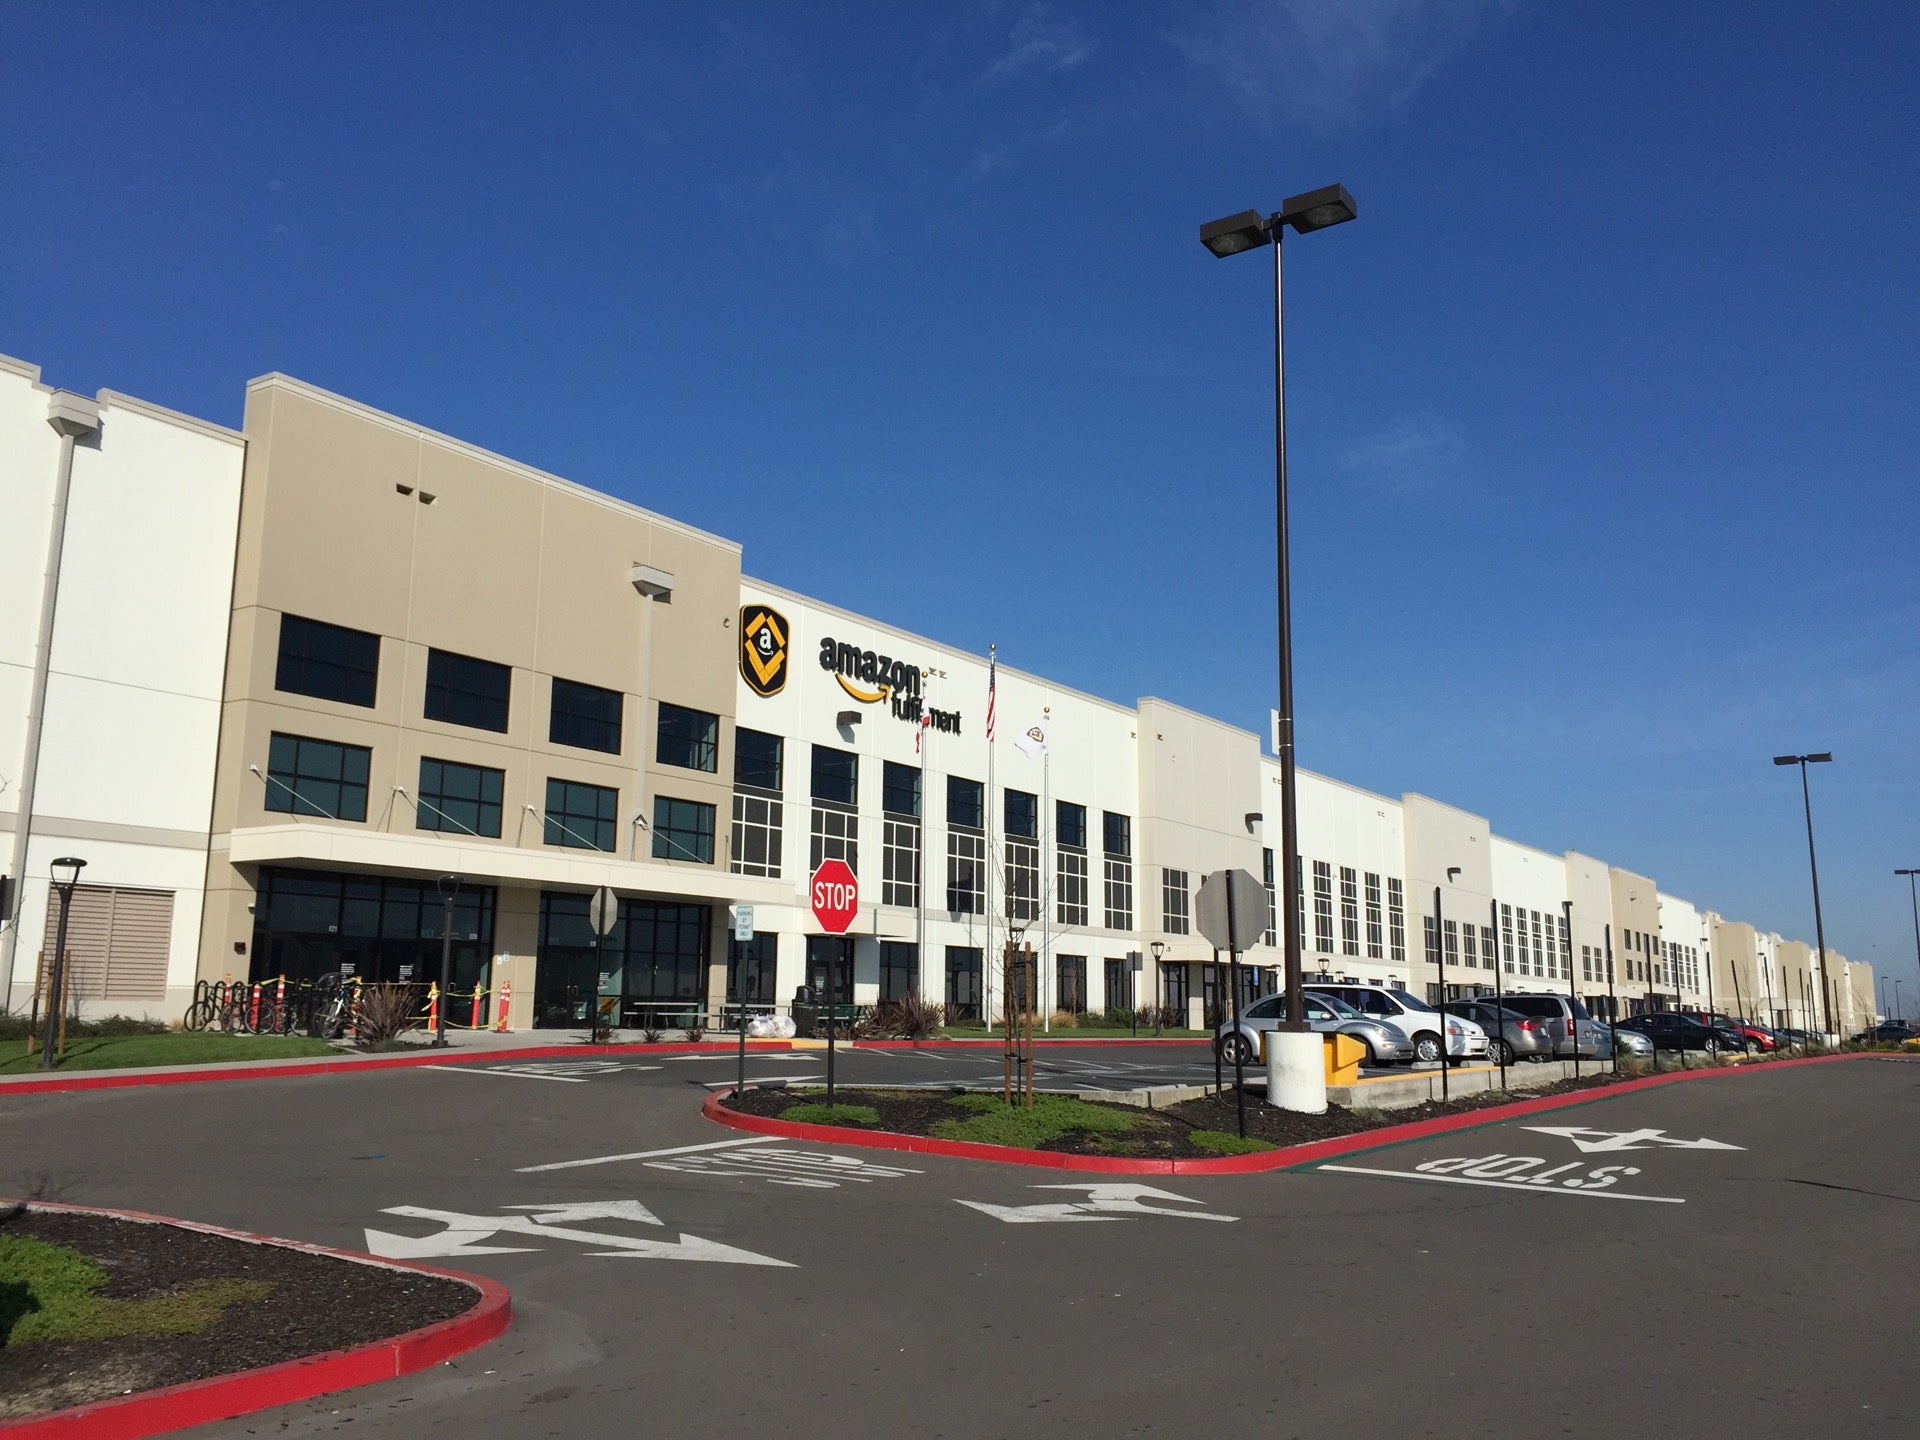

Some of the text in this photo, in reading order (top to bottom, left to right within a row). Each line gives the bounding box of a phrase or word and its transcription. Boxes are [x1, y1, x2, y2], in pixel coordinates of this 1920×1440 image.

[819, 637, 921, 696] amazon
[814, 881, 856, 911] STOP
[1416, 1153, 1642, 1189] STOP
